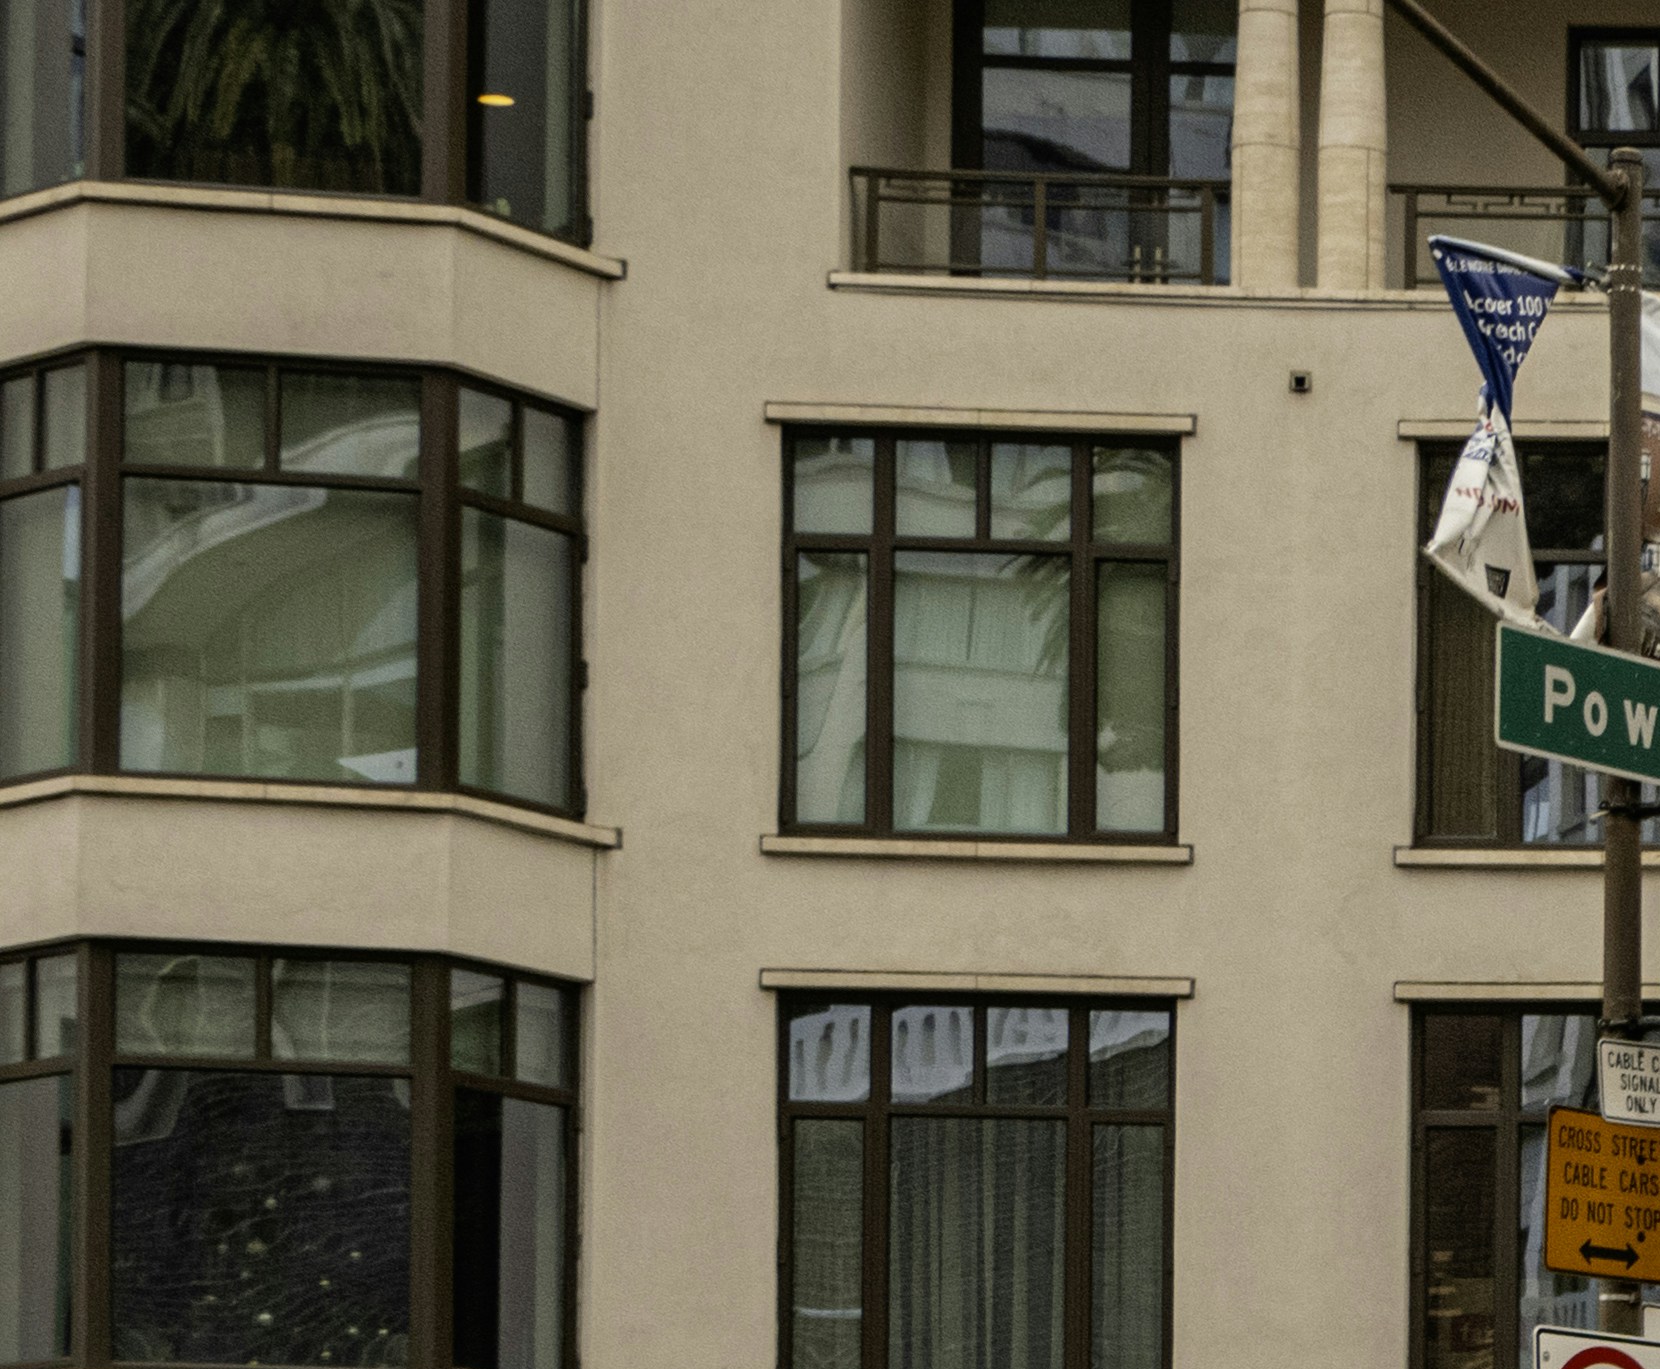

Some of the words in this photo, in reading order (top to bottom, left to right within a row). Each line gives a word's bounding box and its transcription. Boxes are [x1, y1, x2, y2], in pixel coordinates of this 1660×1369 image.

[1607, 1050, 1645, 1072] CABLE
[1626, 1094, 1658, 1114] ONLY
[1558, 1125, 1602, 1154] CROSS
[1564, 1161, 1608, 1190] CABLE
[1619, 1170, 1660, 1197] CARS
[1561, 1197, 1579, 1221] DO
[1587, 1201, 1615, 1226] NOT
